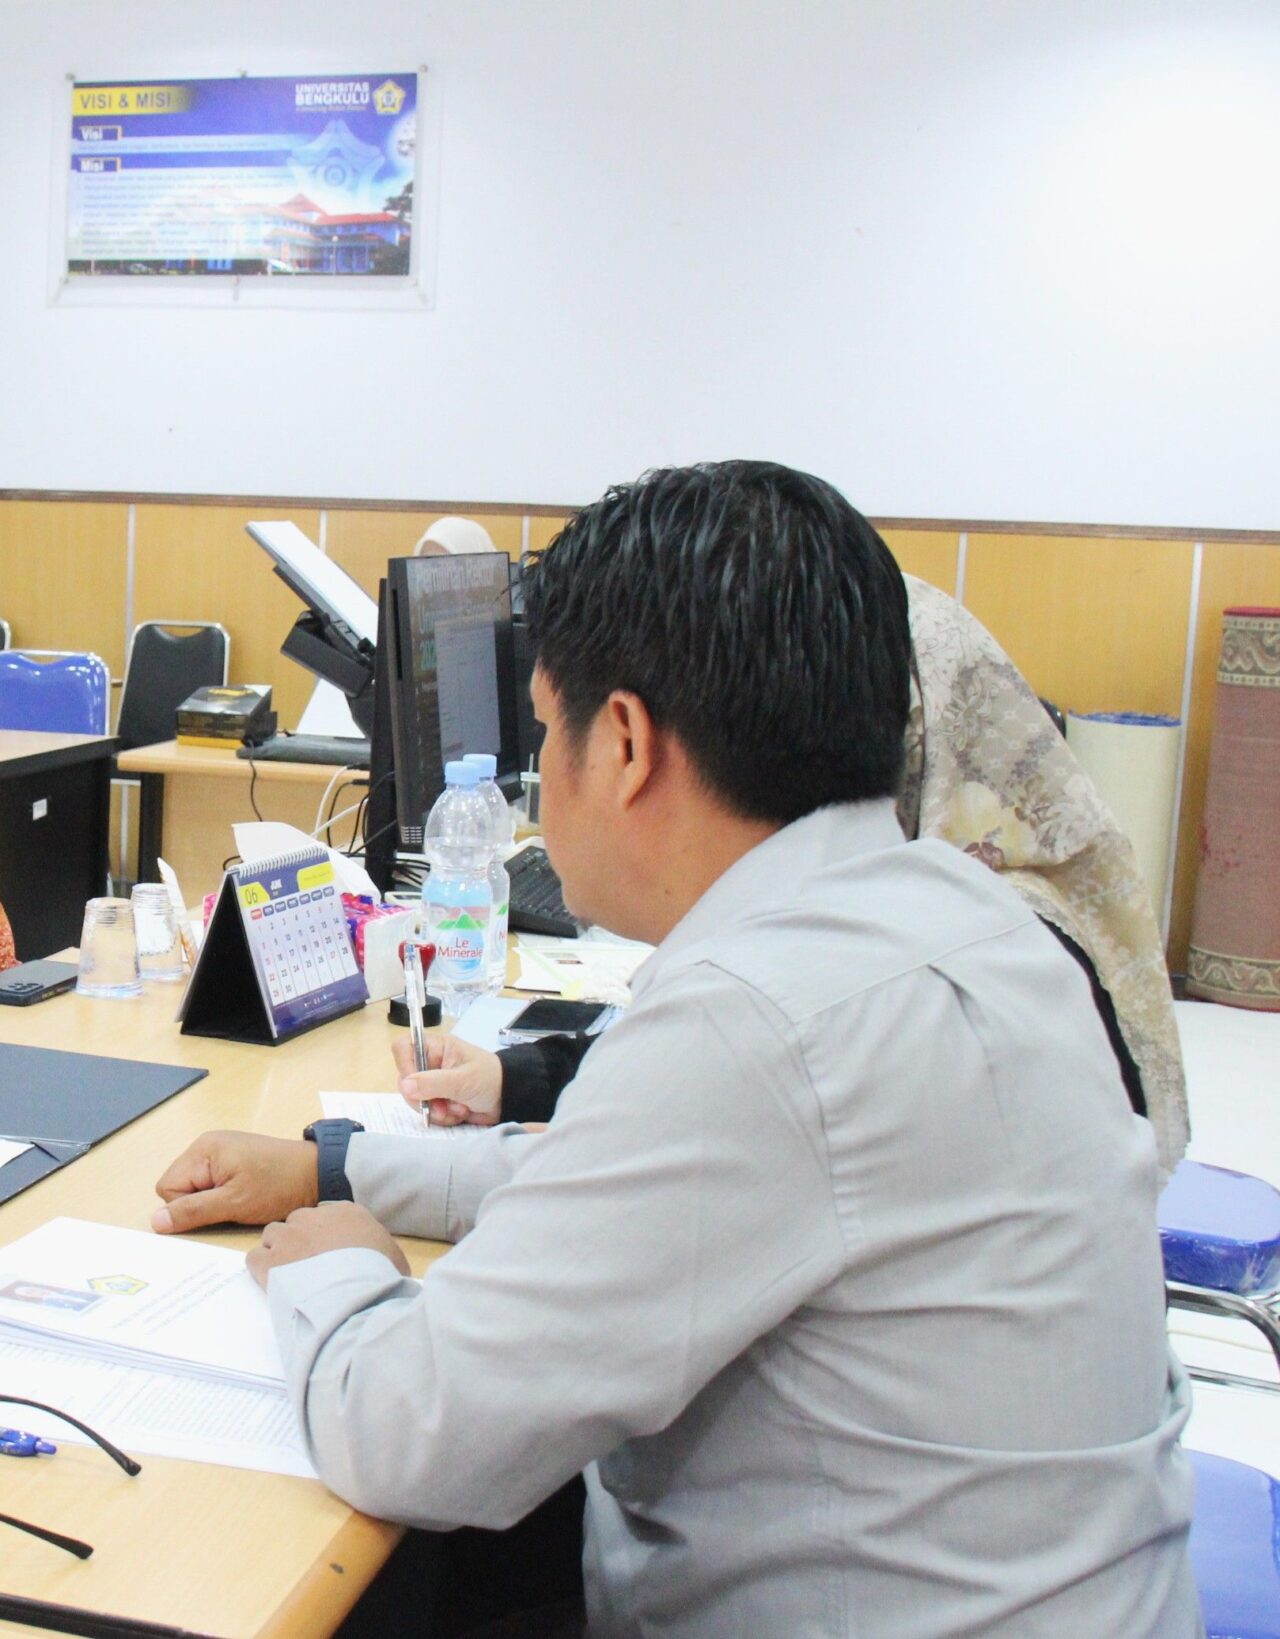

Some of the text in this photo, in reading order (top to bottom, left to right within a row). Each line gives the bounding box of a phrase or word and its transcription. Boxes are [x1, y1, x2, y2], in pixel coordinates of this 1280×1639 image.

[295, 82, 370, 94] UNIVERSITAS
[80, 92, 171, 109] VISI & MISI
[295, 92, 370, 106] BENGKULU
[81, 126, 104, 140] Visi
[80, 158, 104, 172] Misi
[244, 888, 258, 905] 06
[455, 937, 469, 948] Le
[438, 946, 483, 958] Minerale
